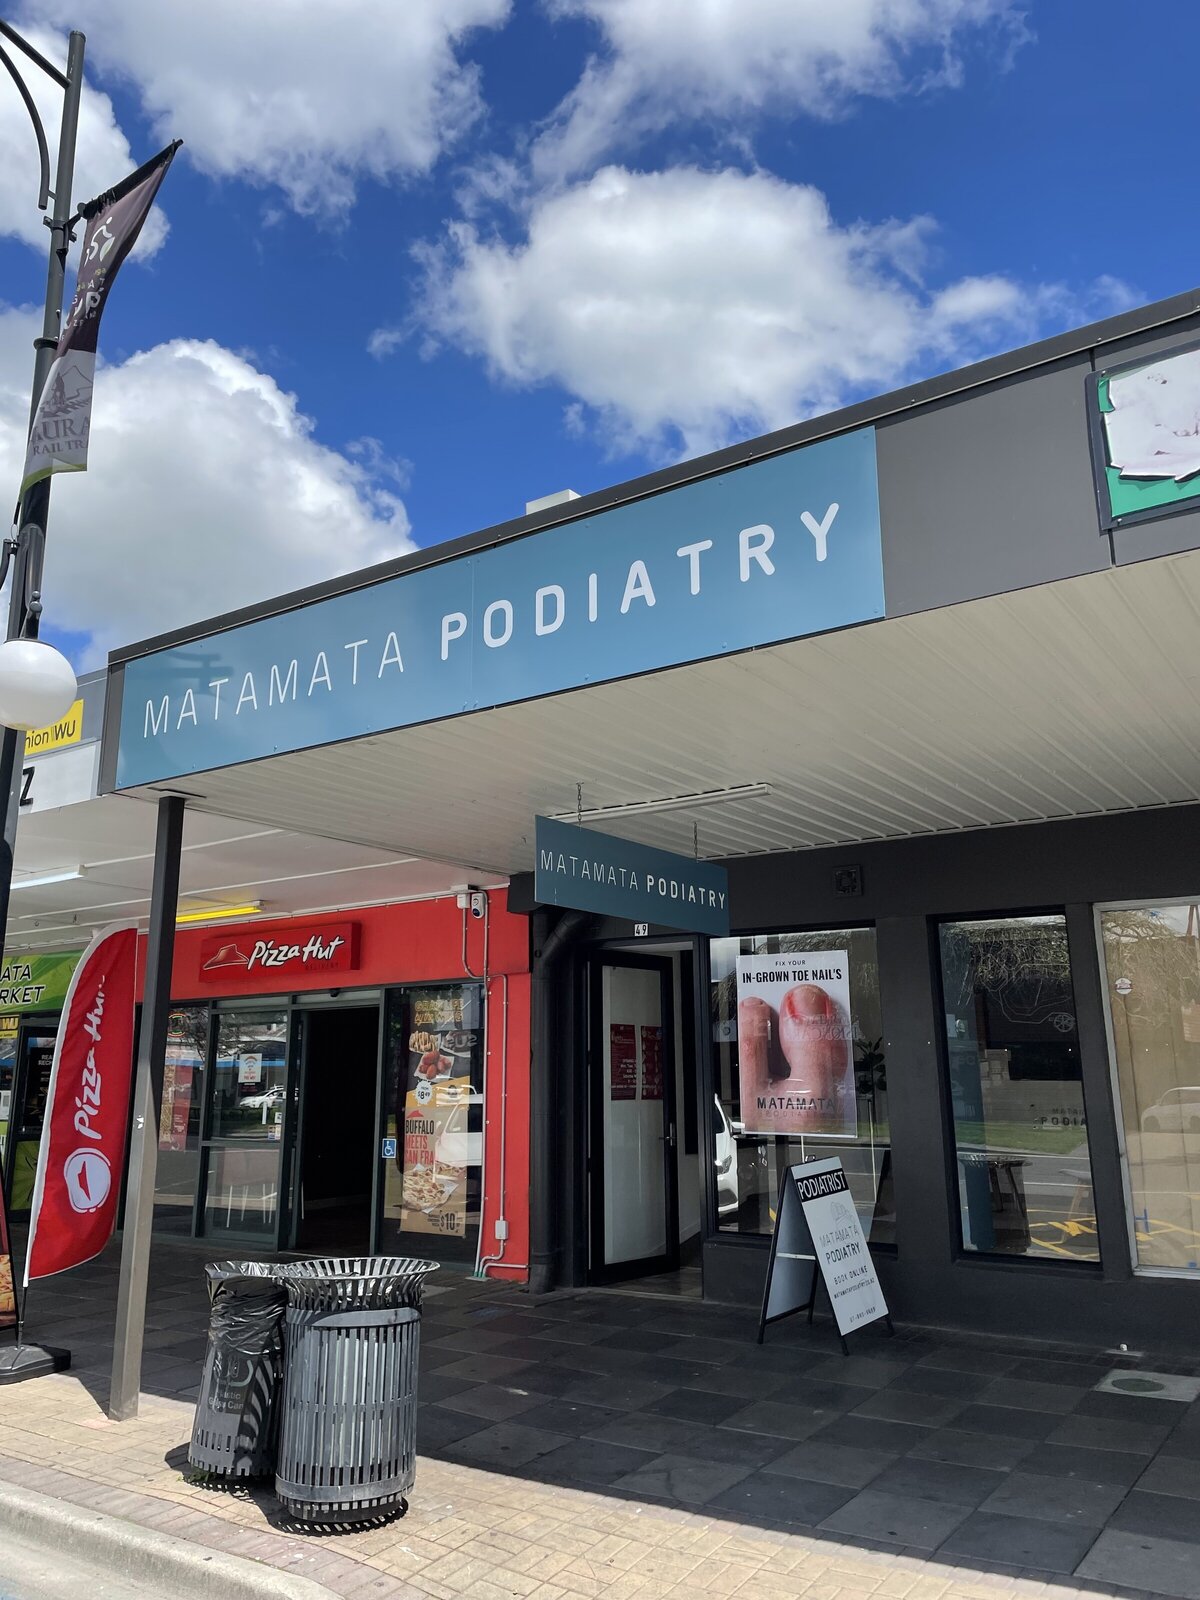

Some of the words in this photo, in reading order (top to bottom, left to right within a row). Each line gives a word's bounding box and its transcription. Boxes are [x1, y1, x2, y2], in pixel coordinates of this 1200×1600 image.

[142, 631, 405, 738] MATAMATA
[440, 502, 840, 662] PODIATRY
[541, 849, 638, 891] MATAMATA
[647, 874, 725, 910] PODIATRY
[635, 924, 647, 936] 49
[247, 940, 301, 970] Pizza
[302, 935, 345, 963] Hut
[742, 971, 790, 984] IN-GROWN
[792, 969, 810, 982] TOE
[812, 968, 842, 981] NAIL'S
[74, 1047, 102, 1140] Pizza
[757, 1097, 835, 1111] MATAMATA
[405, 1119, 435, 1135] BUFFALO
[798, 1171, 846, 1200] PODIATRIST
[819, 1225, 860, 1248] MATAMATA
[825, 1242, 861, 1265] PODIATRY
[849, 1265, 868, 1279] ONLINE
